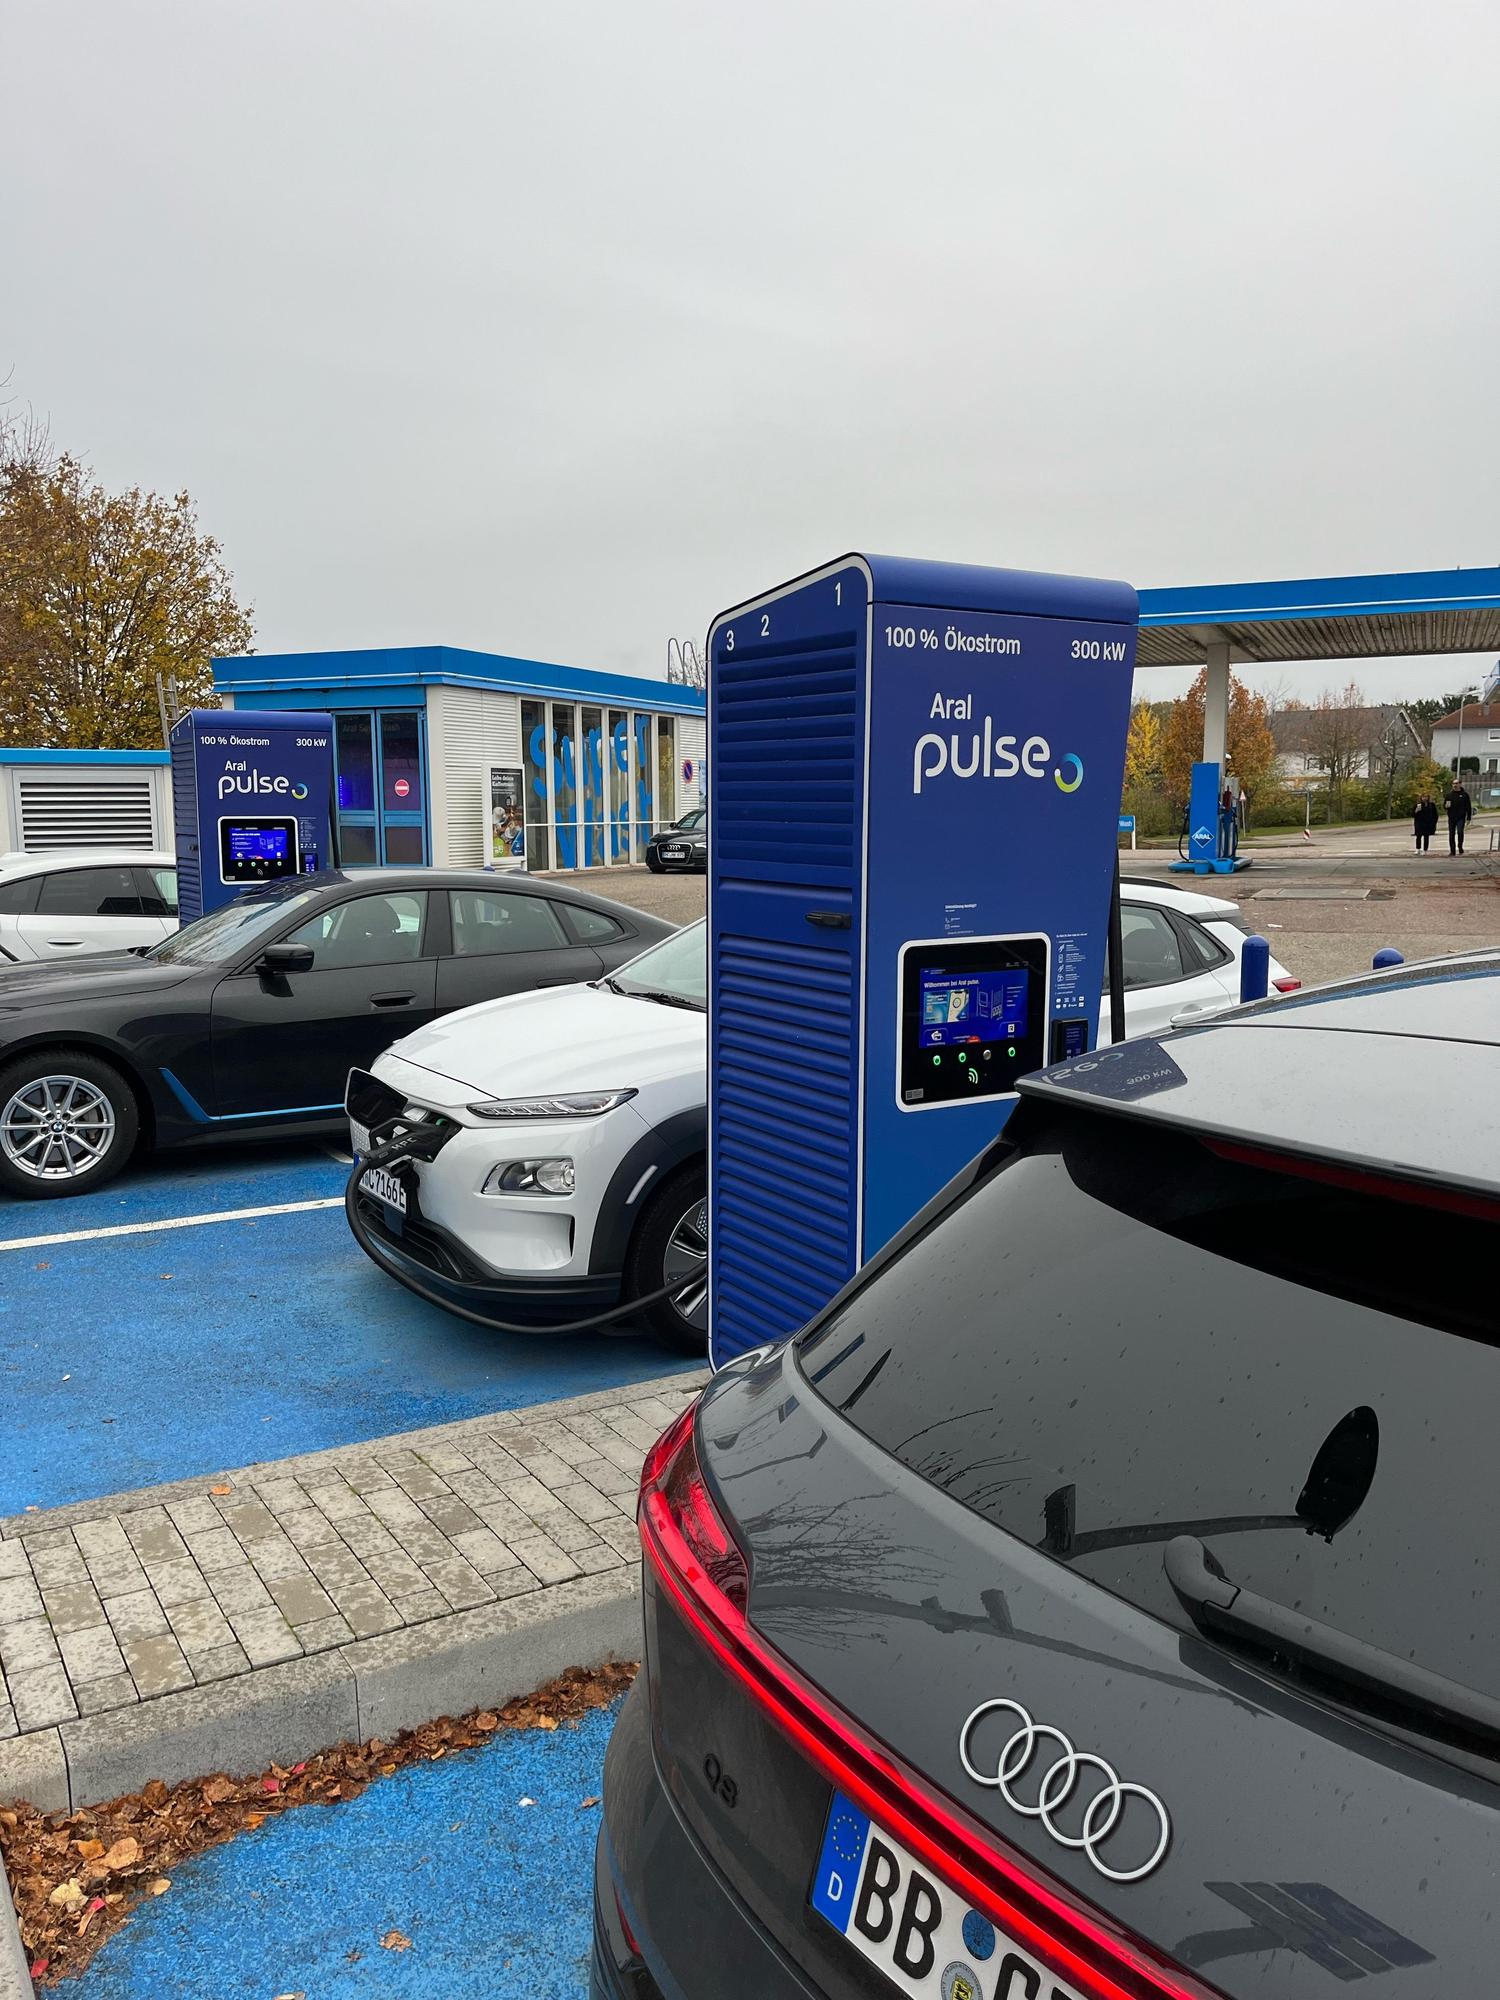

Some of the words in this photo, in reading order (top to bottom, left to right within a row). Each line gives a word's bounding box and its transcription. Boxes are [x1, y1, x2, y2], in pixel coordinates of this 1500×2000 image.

[835, 582, 841, 605] 1
[760, 615, 770, 637] 2
[726, 630, 735, 652] 3
[885, 626, 916, 649] 100
[920, 630, 939, 650] %
[944, 627, 1021, 655] Ökostrom
[1071, 640, 1100, 660] 300
[1103, 641, 1126, 661] kW
[929, 692, 972, 720] Aral
[200, 736, 216, 745] 100
[217, 737, 227, 745] %
[230, 735, 270, 746] Ökostrom
[296, 738, 312, 747] 300
[314, 739, 326, 747] kW
[224, 760, 247, 771] Aral
[913, 716, 1050, 794] pulse
[218, 769, 290, 800] pulse
[827, 1871, 843, 1901] D
[854, 1836, 942, 1980] BB
